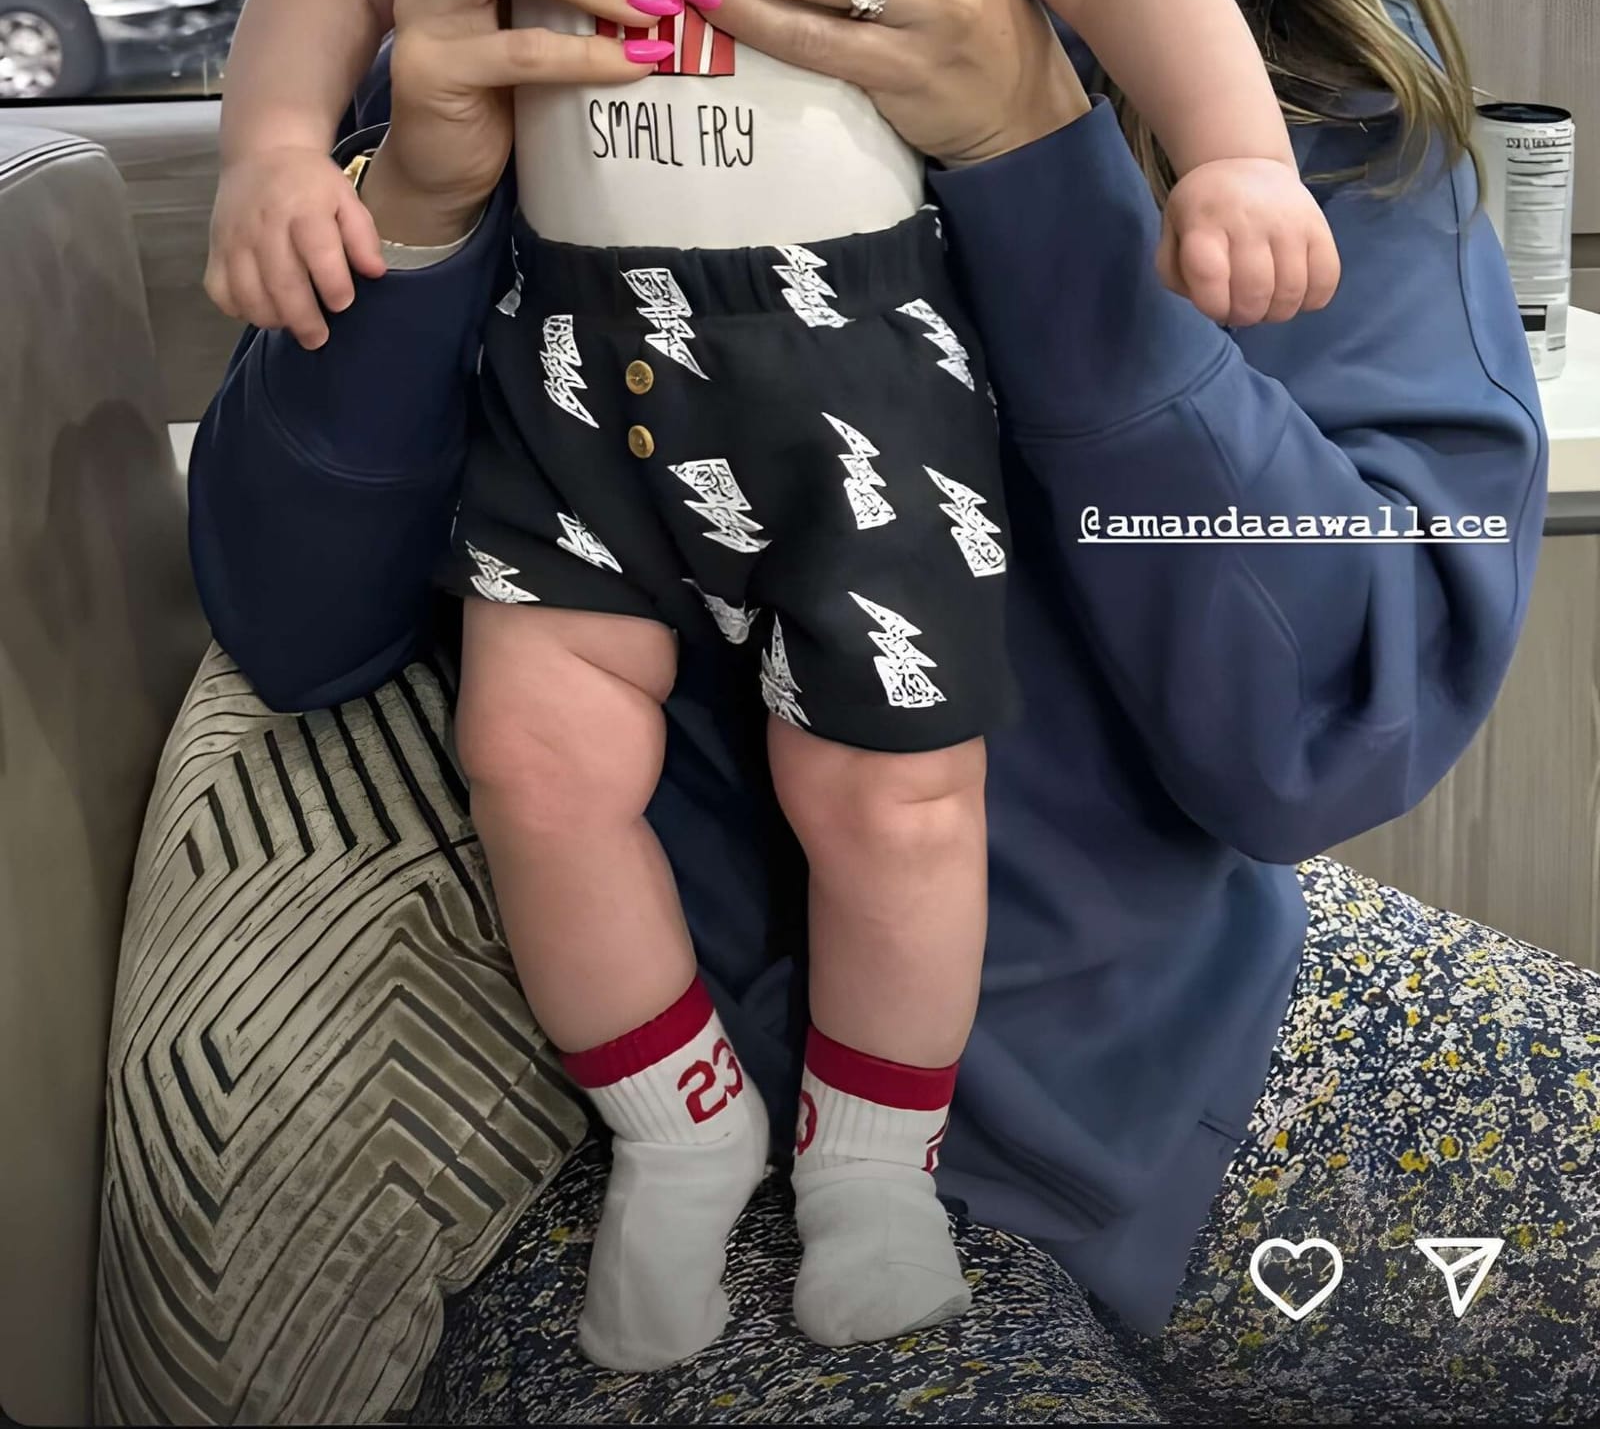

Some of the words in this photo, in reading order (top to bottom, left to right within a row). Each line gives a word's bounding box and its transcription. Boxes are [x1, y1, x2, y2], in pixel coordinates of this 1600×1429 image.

[589, 99, 683, 166] SMALL
[698, 104, 754, 168] FRY
[678, 1038, 744, 1124] 23
